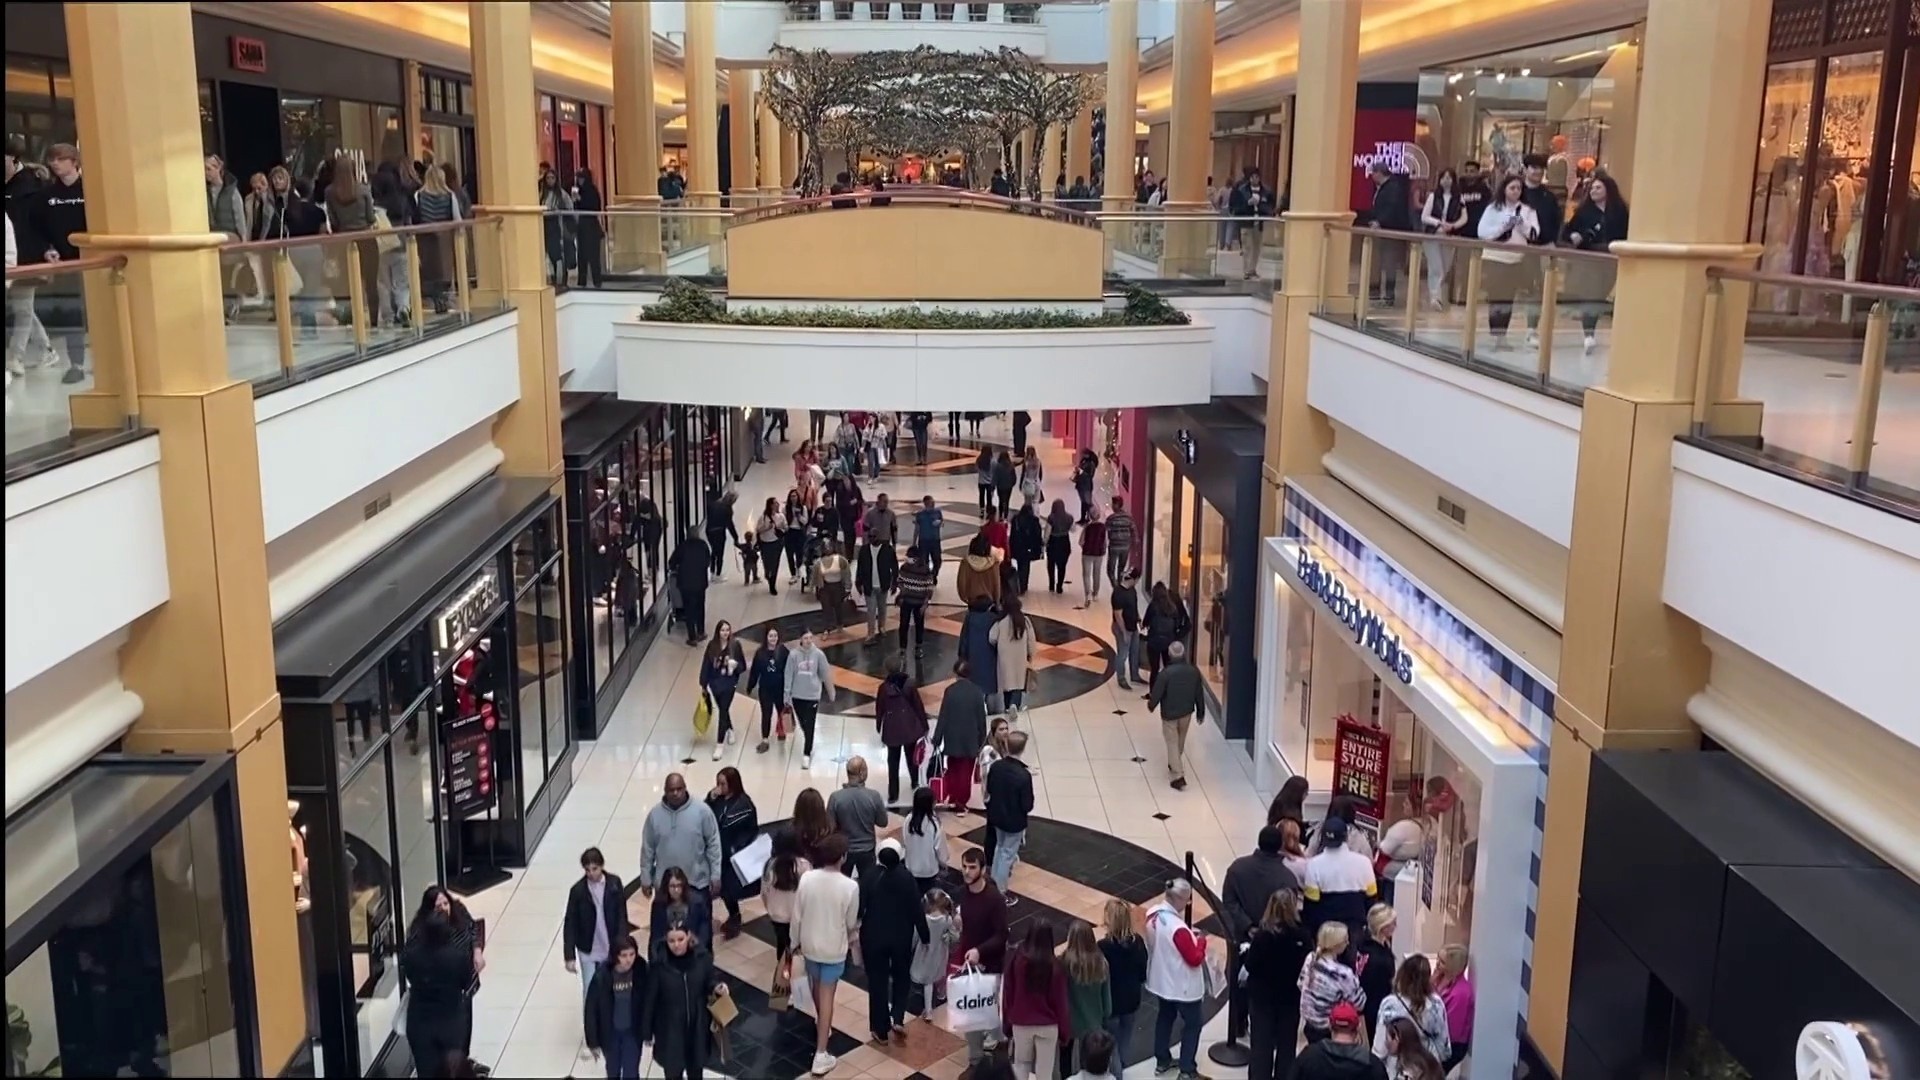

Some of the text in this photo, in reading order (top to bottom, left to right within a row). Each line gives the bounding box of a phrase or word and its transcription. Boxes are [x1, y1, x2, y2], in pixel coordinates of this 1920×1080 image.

[1341, 740, 1382, 762] ENTIRE
[1341, 752, 1382, 774] STORE
[1339, 774, 1379, 800] FREE
